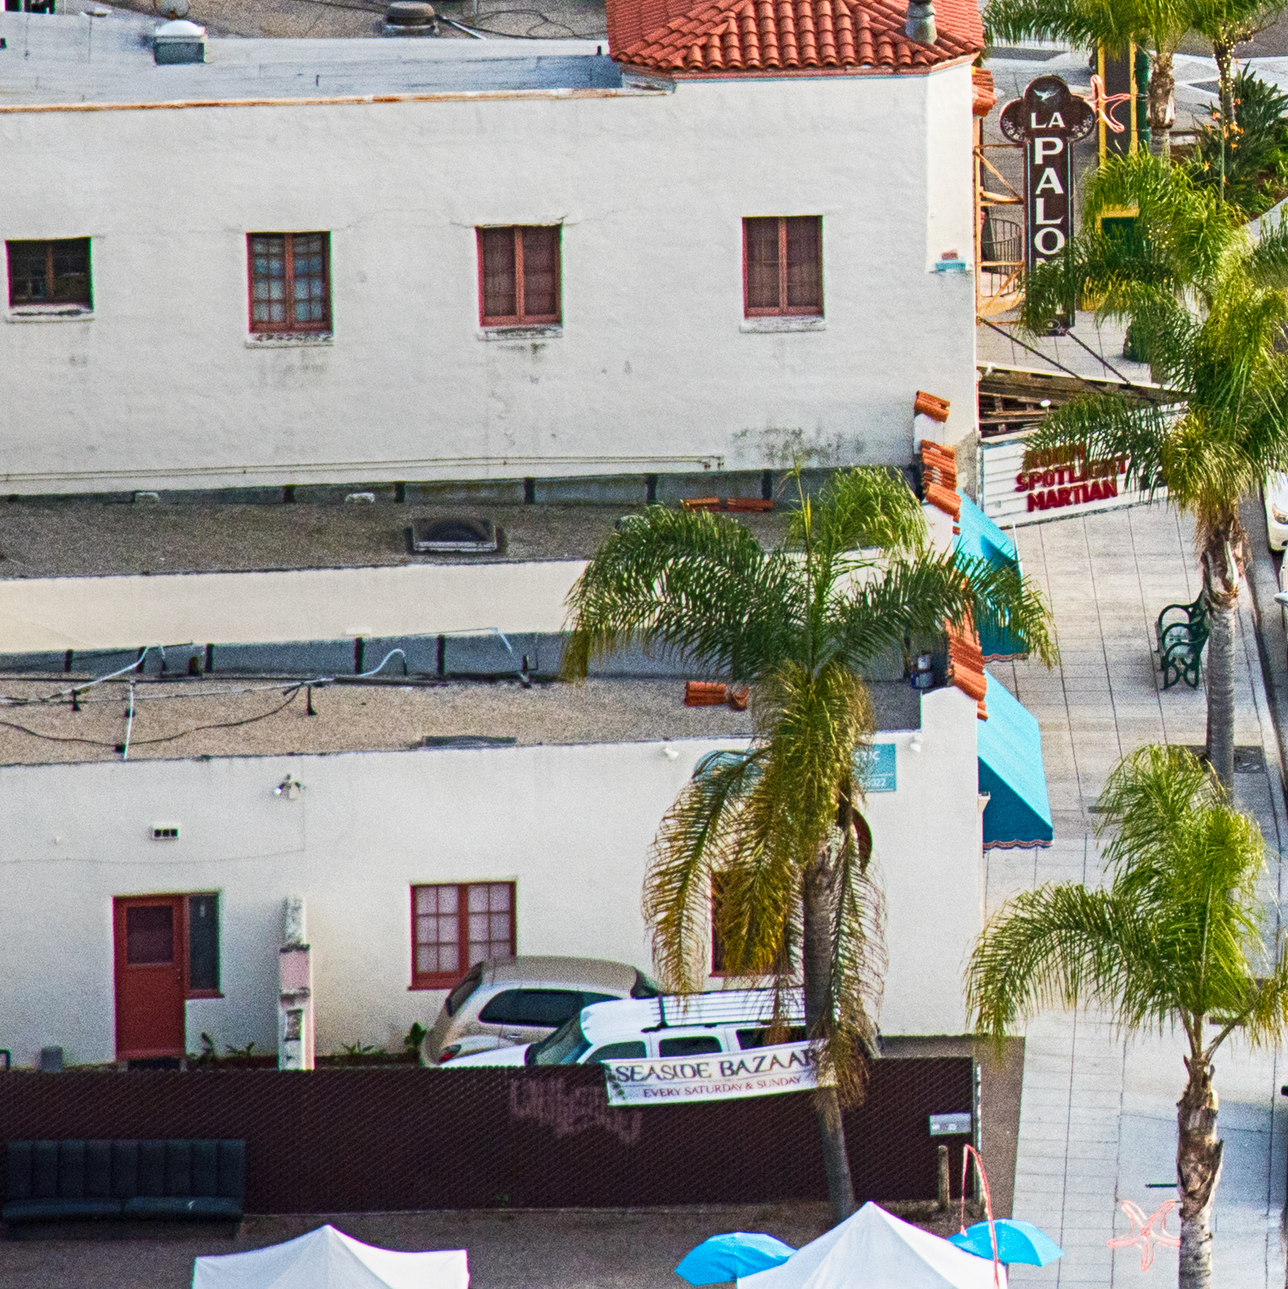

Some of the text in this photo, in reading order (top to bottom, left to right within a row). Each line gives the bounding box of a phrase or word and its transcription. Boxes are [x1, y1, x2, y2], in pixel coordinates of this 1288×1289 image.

[1030, 111, 1066, 129] LA
[1026, 479, 1118, 513] MARTIAN
[614, 1049, 818, 1083] SEASIDE BAZAAR
[643, 1075, 801, 1098] EVERY SATURDAY & SUNDAY
